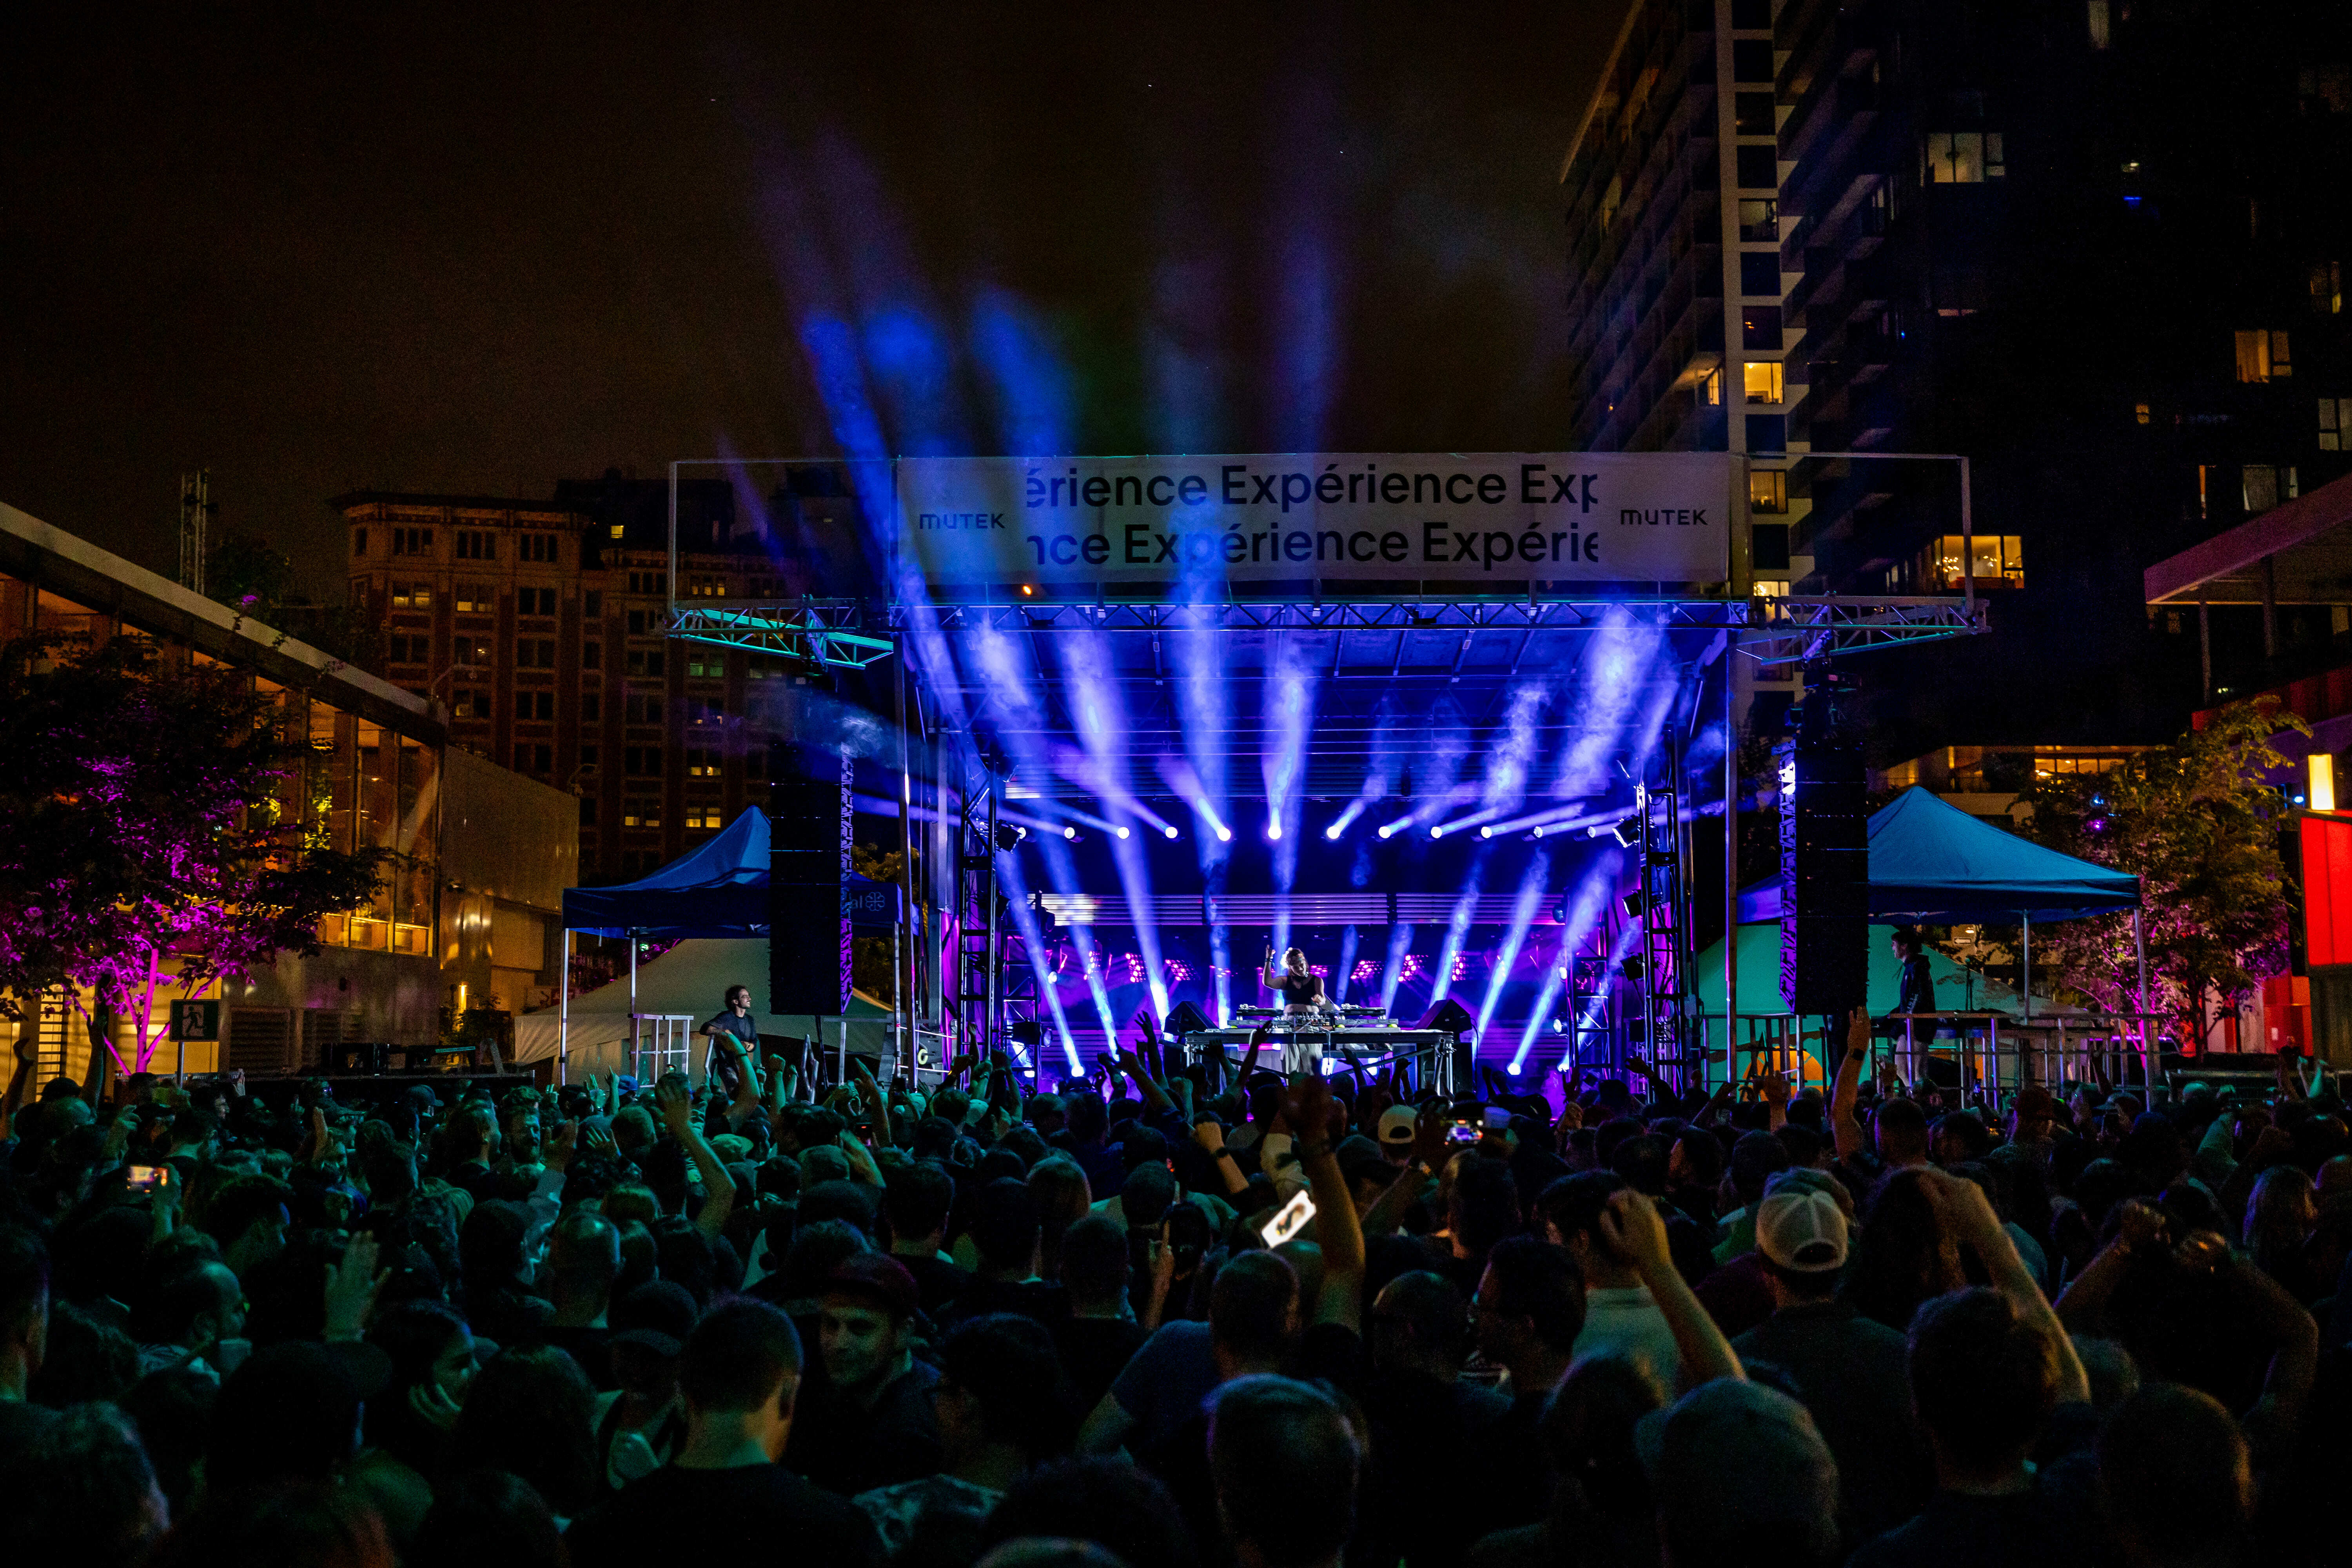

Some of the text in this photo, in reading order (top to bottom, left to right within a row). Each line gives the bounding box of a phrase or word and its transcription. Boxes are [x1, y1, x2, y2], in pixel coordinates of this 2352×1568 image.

[1026, 464, 1598, 513] érience Expérience Exp
[1125, 523, 1409, 572] Expérience
[1423, 522, 1599, 571] Expérie
